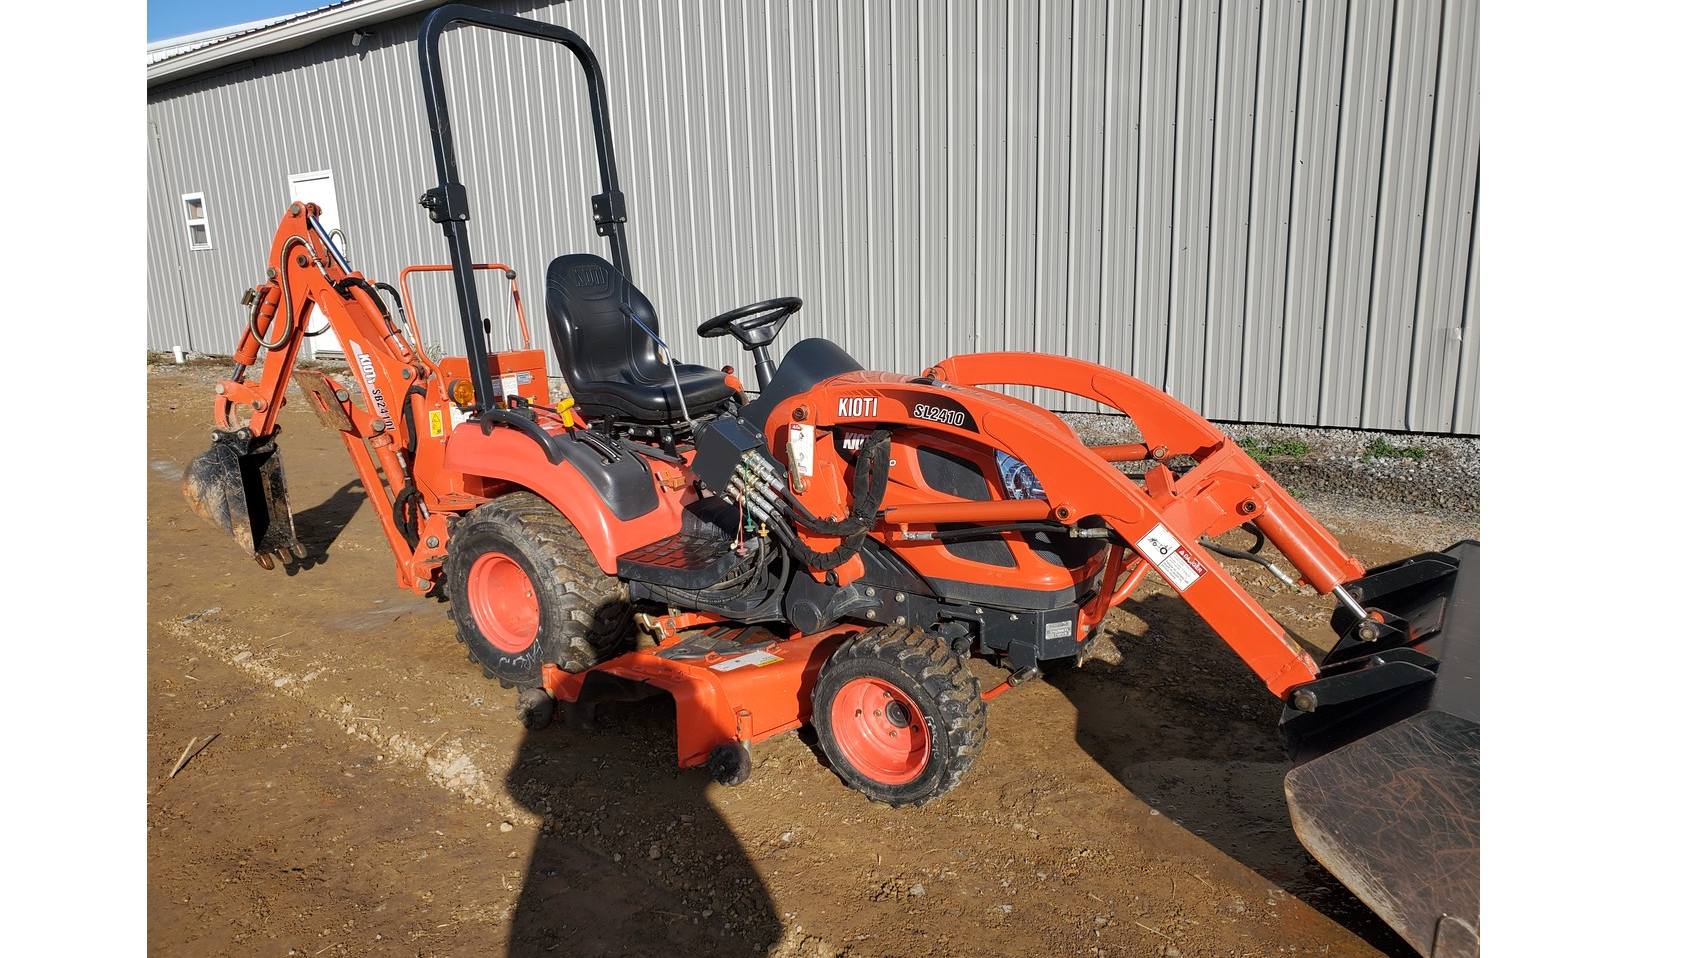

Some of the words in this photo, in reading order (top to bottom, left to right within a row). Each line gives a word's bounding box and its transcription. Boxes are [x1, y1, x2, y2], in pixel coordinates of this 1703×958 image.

[837, 397, 879, 417] KIOTI
[913, 404, 966, 426] SL2410
[1183, 553, 1204, 573] DGER
